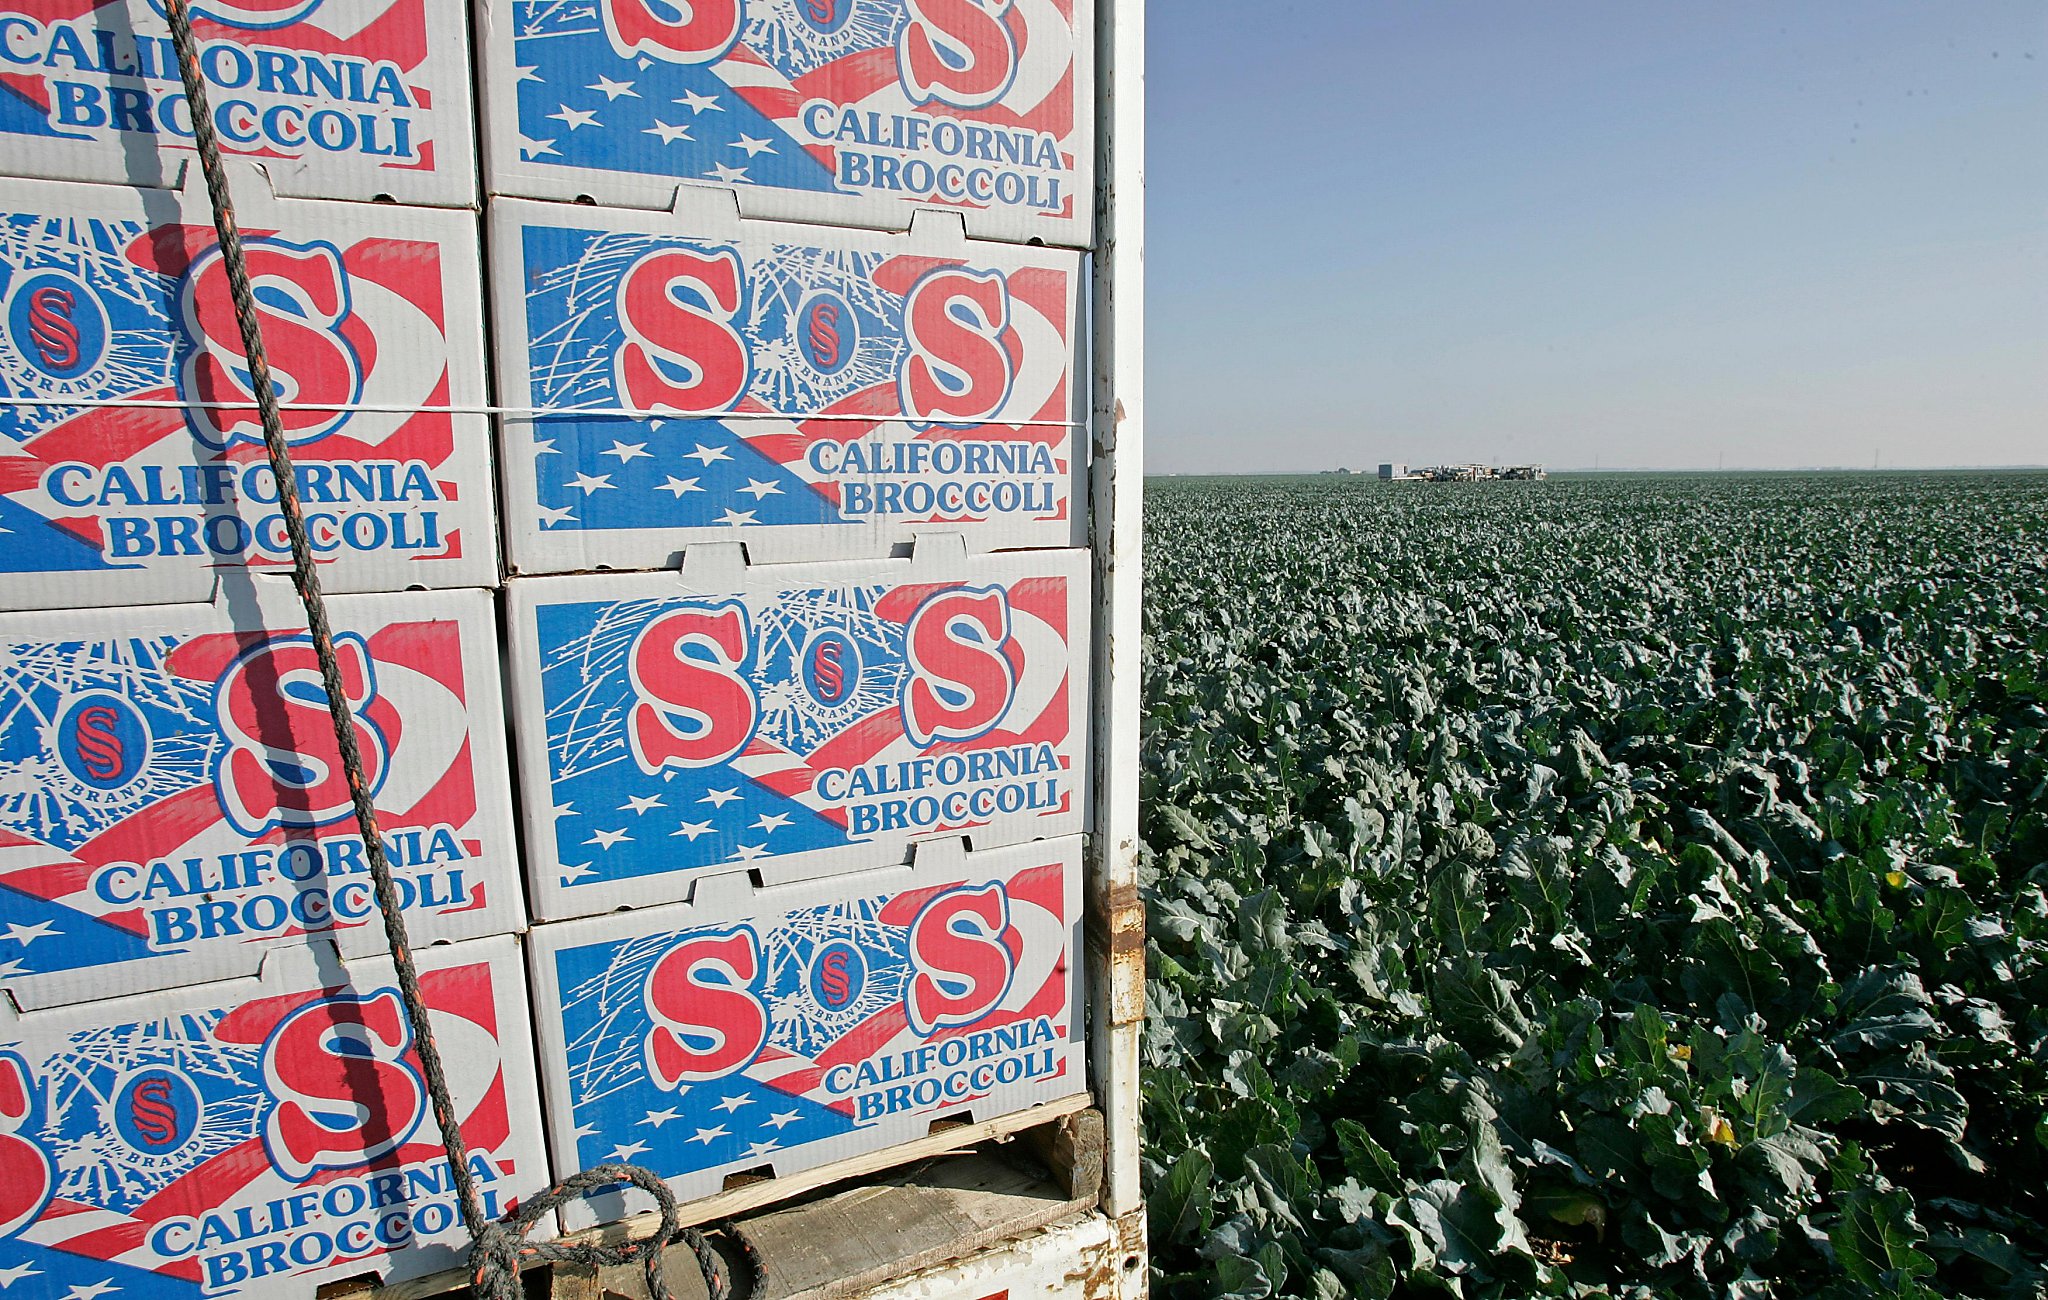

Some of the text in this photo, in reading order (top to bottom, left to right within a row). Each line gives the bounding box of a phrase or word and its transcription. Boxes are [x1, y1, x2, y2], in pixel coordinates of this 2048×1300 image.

[795, 22, 850, 47] BRAND
[53, 80, 412, 157] BROCCOLI
[804, 104, 1060, 170] CALIFORNIA
[841, 152, 1062, 209] BROCCOLI
[20, 367, 106, 394] BRAND
[801, 366, 853, 387] BRAND
[809, 442, 1054, 475] CALIFORNIA
[47, 464, 439, 508] CALIFORNIA
[844, 482, 1054, 515] BROCCOLI
[106, 512, 441, 558] BROCCOLI
[807, 698, 858, 719] BRAND
[69, 777, 148, 803] BRAND
[817, 745, 1058, 800] CALIFORNIA
[852, 779, 1058, 837] BROCCOLI
[95, 829, 464, 904] CALIFORNIA
[151, 870, 466, 945] BROCCOLI
[815, 1000, 863, 1021] BRAND
[825, 1019, 1056, 1095] CALIFORNIA
[859, 1048, 1055, 1121] BROCCOLI
[125, 1141, 200, 1167] BRAND
[152, 1154, 498, 1258] CALIFORNIA
